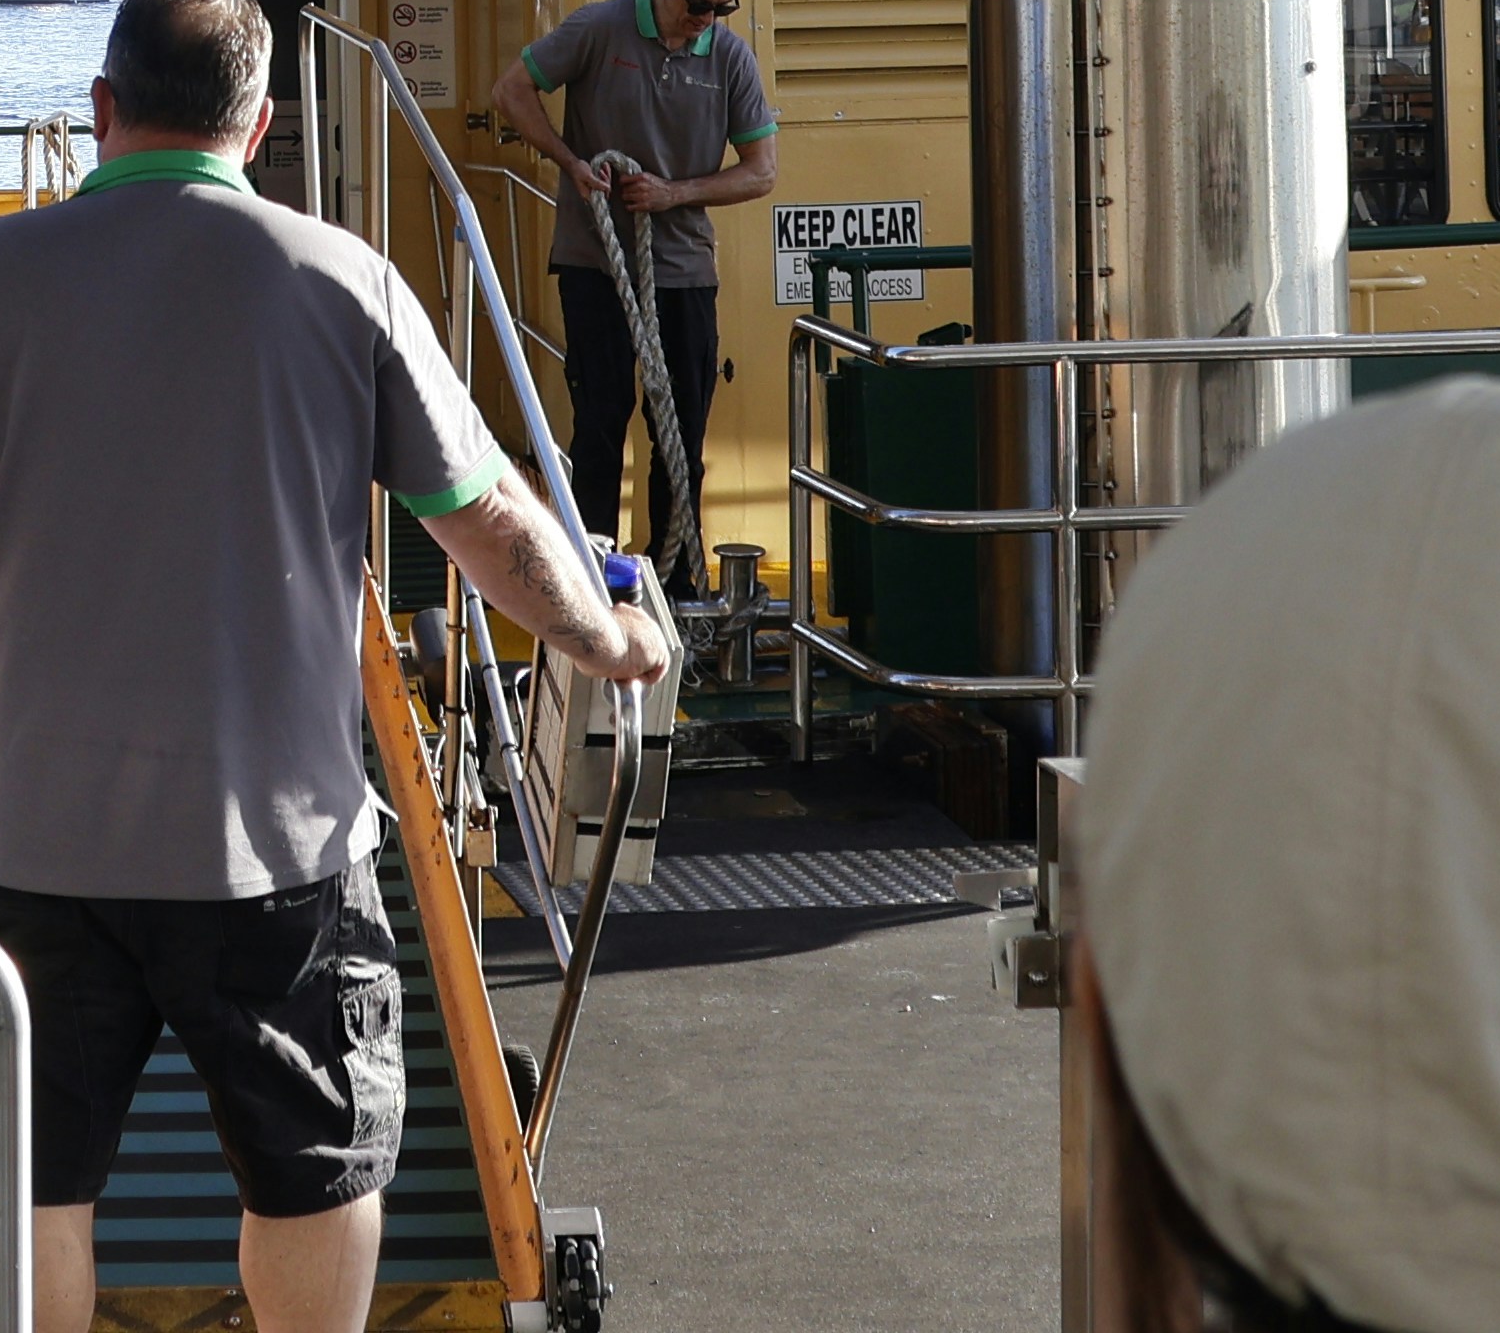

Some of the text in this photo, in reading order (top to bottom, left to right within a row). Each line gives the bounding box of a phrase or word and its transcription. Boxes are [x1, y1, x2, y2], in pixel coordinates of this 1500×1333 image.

[777, 206, 918, 249] KEEP CLEAR
[785, 279, 855, 300] EMEENC
